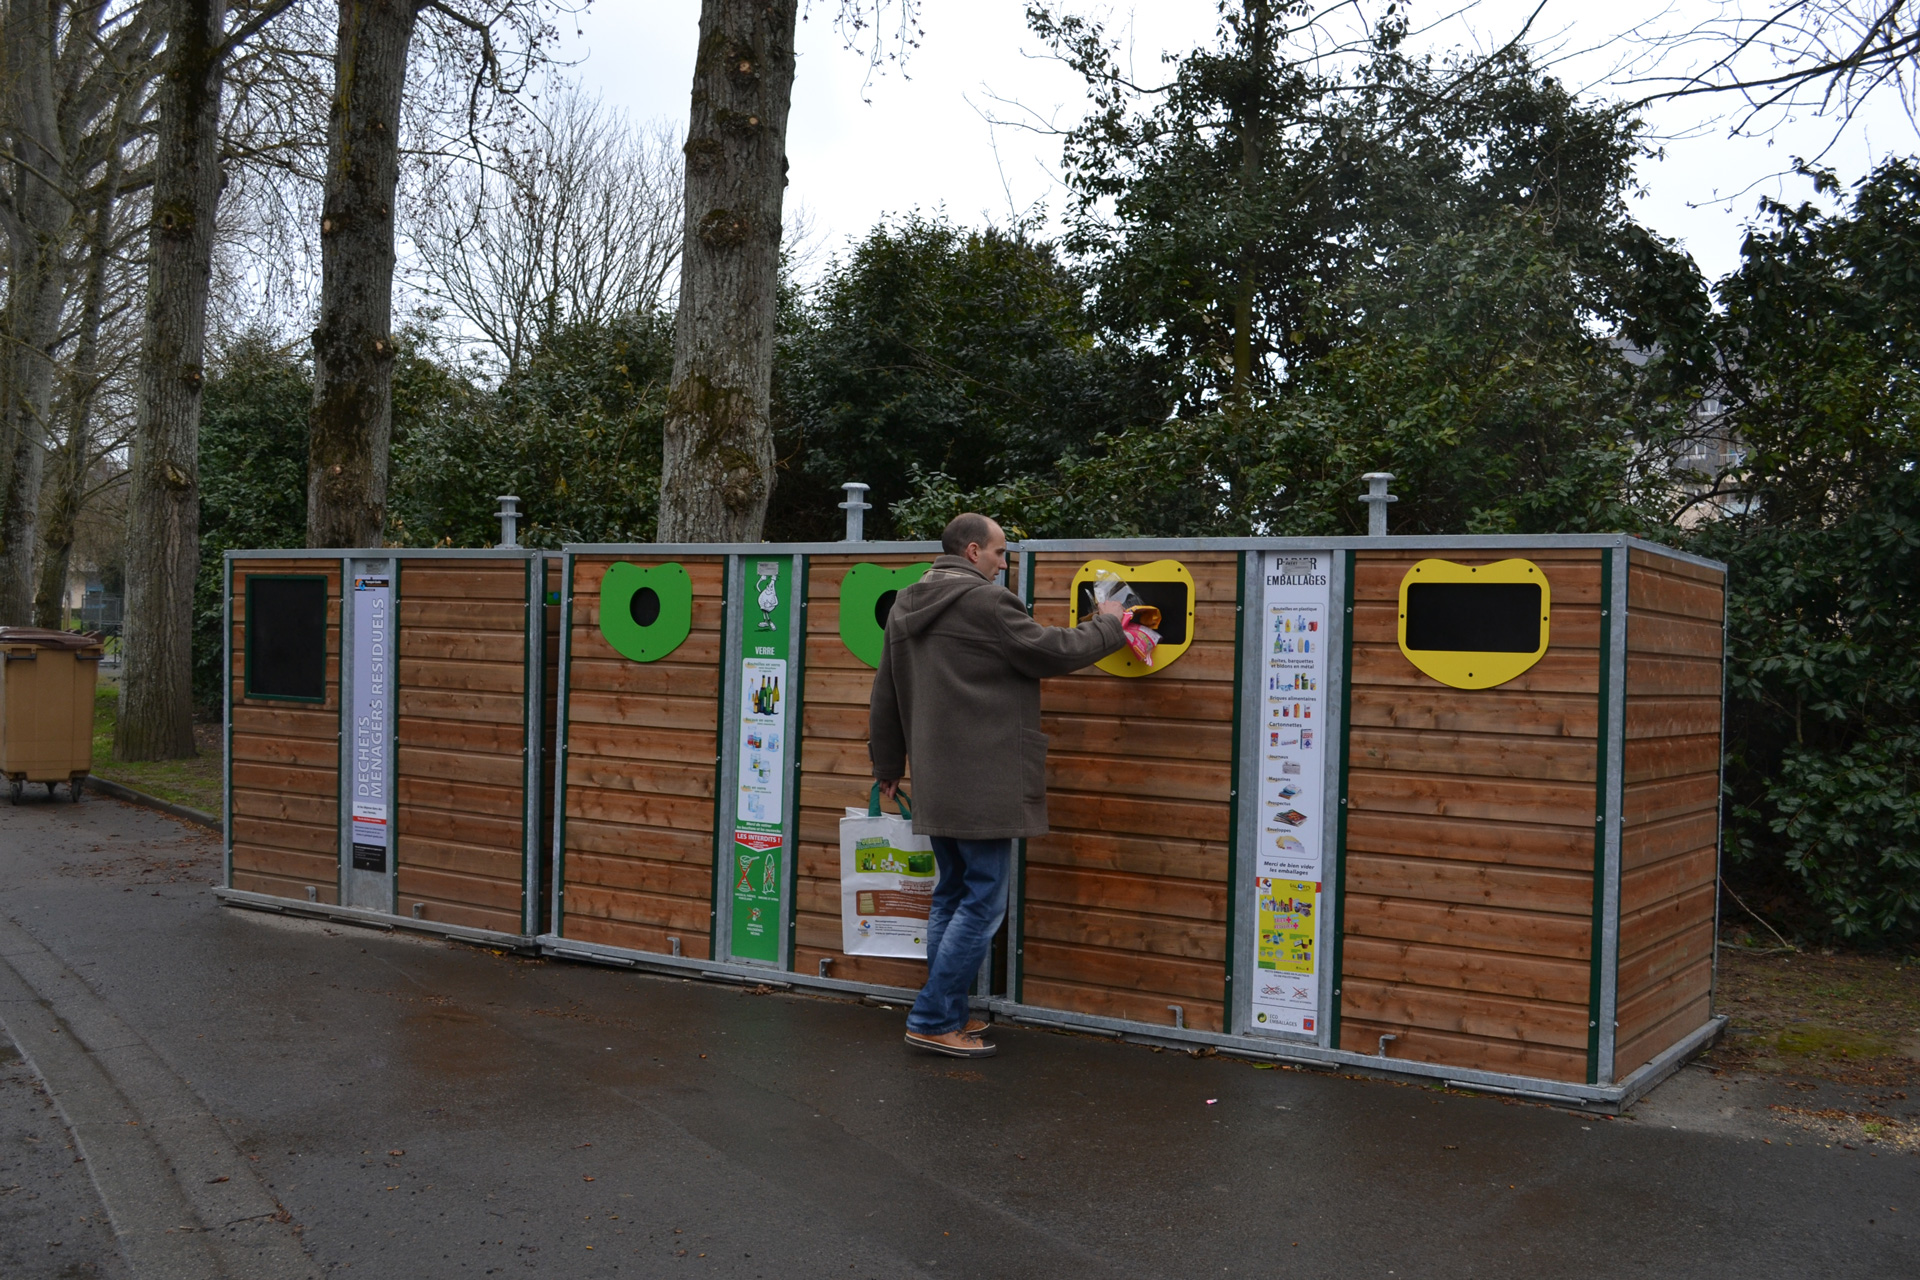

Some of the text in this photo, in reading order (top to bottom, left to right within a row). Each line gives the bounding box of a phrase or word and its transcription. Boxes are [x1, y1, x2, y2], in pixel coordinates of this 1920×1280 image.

[1266, 574, 1327, 586] EMBALLAGES
[371, 598, 384, 695] RESIDUELS
[755, 646, 775, 656] VERRE
[370, 699, 383, 798] MENAGERS
[358, 716, 370, 796] DECHETS
[748, 834, 777, 843] INTERDITS
[1278, 868, 1308, 876] emballages
